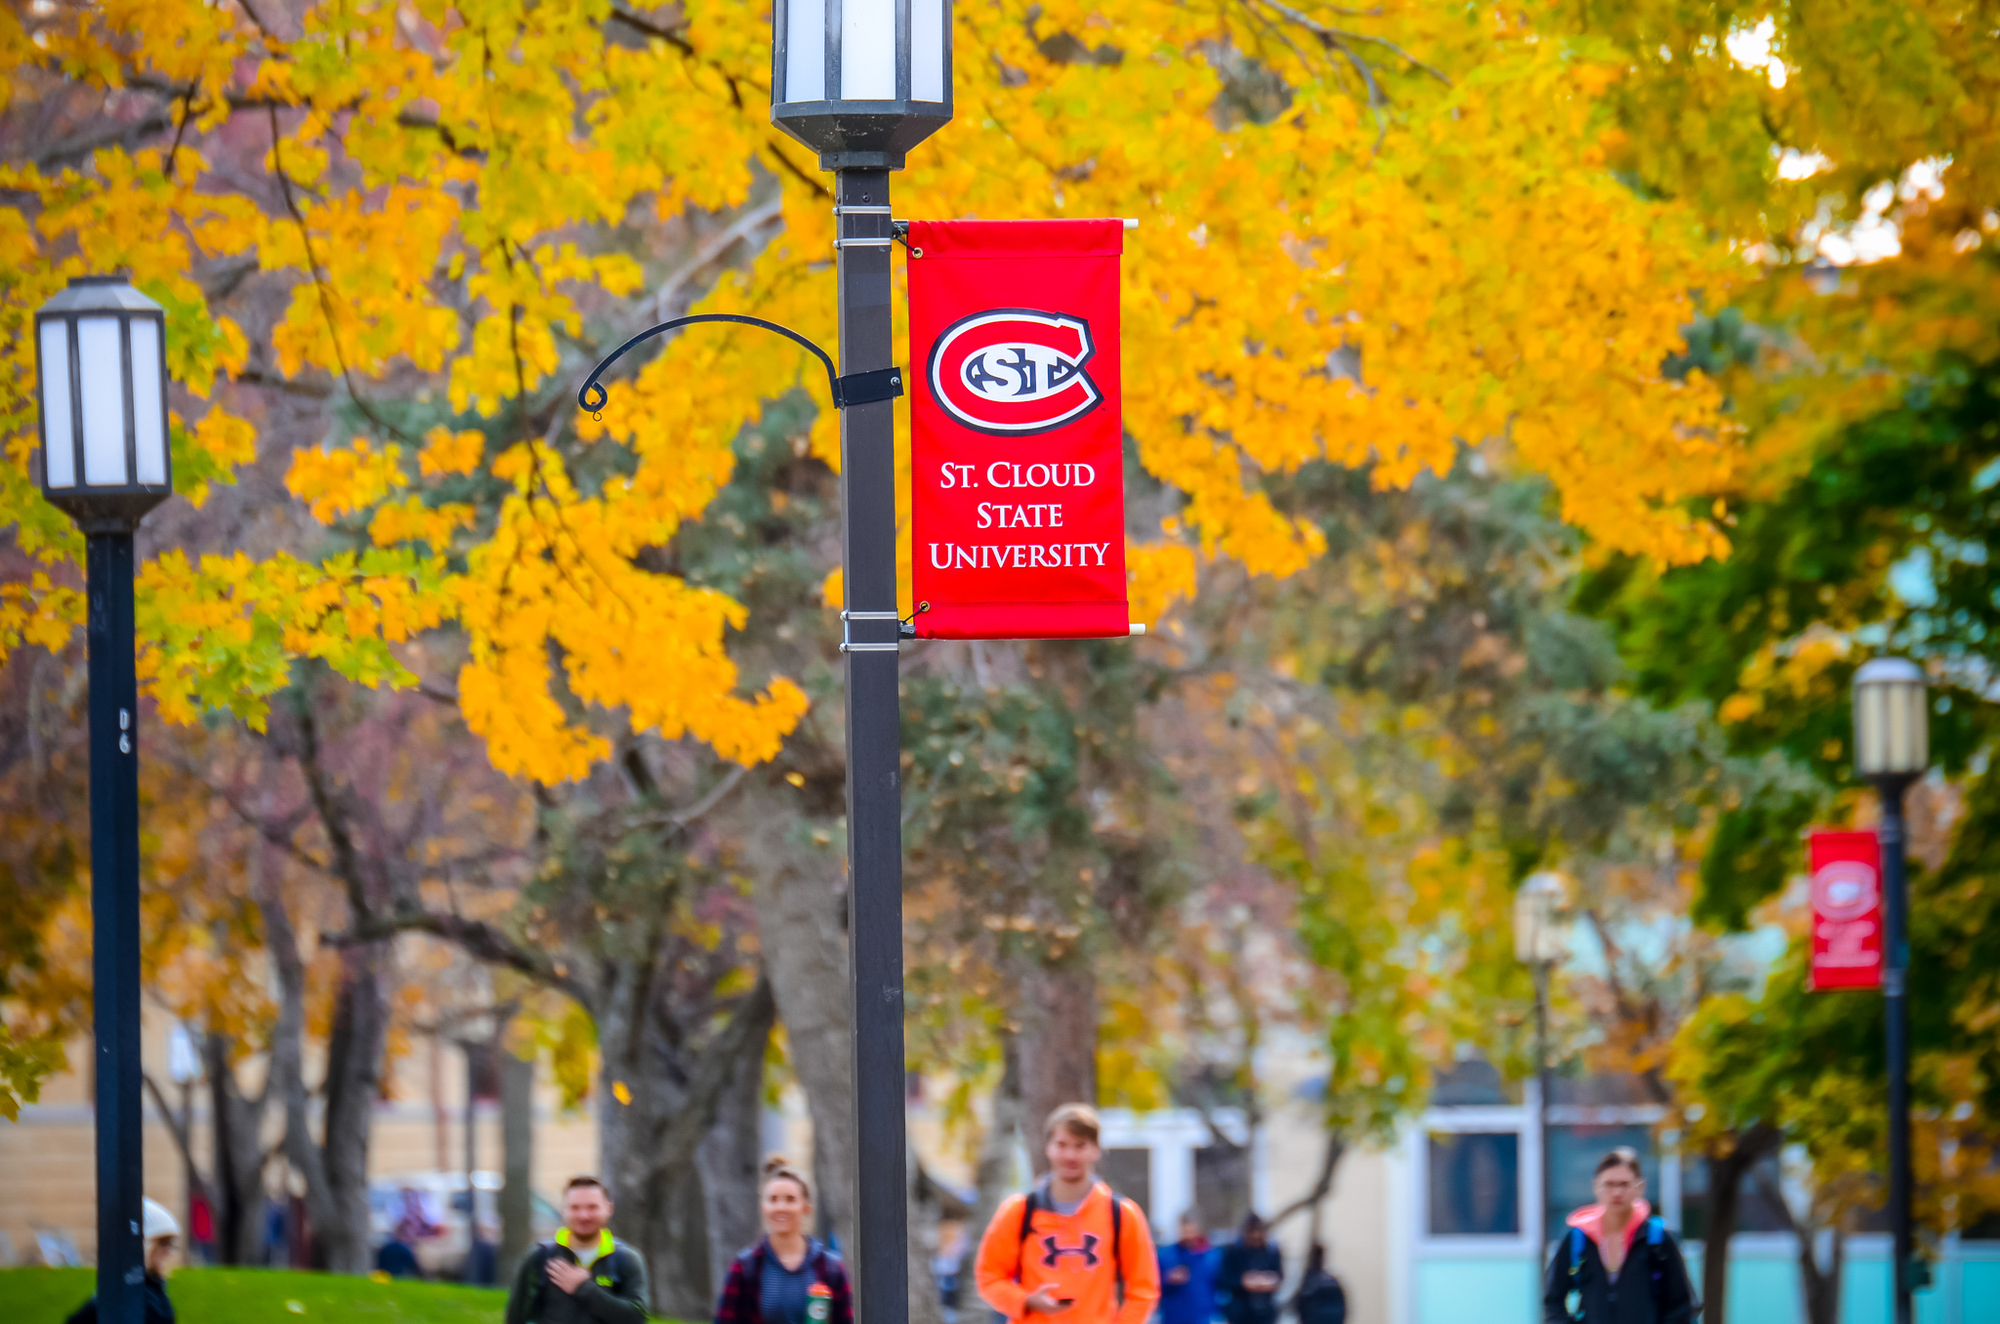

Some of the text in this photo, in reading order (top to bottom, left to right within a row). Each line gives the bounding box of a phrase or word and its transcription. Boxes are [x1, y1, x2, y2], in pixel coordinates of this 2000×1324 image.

[940, 461, 1096, 489] ST. CLOUD
[976, 502, 1064, 529] STATE
[928, 542, 1111, 570] UNIVERSITY
